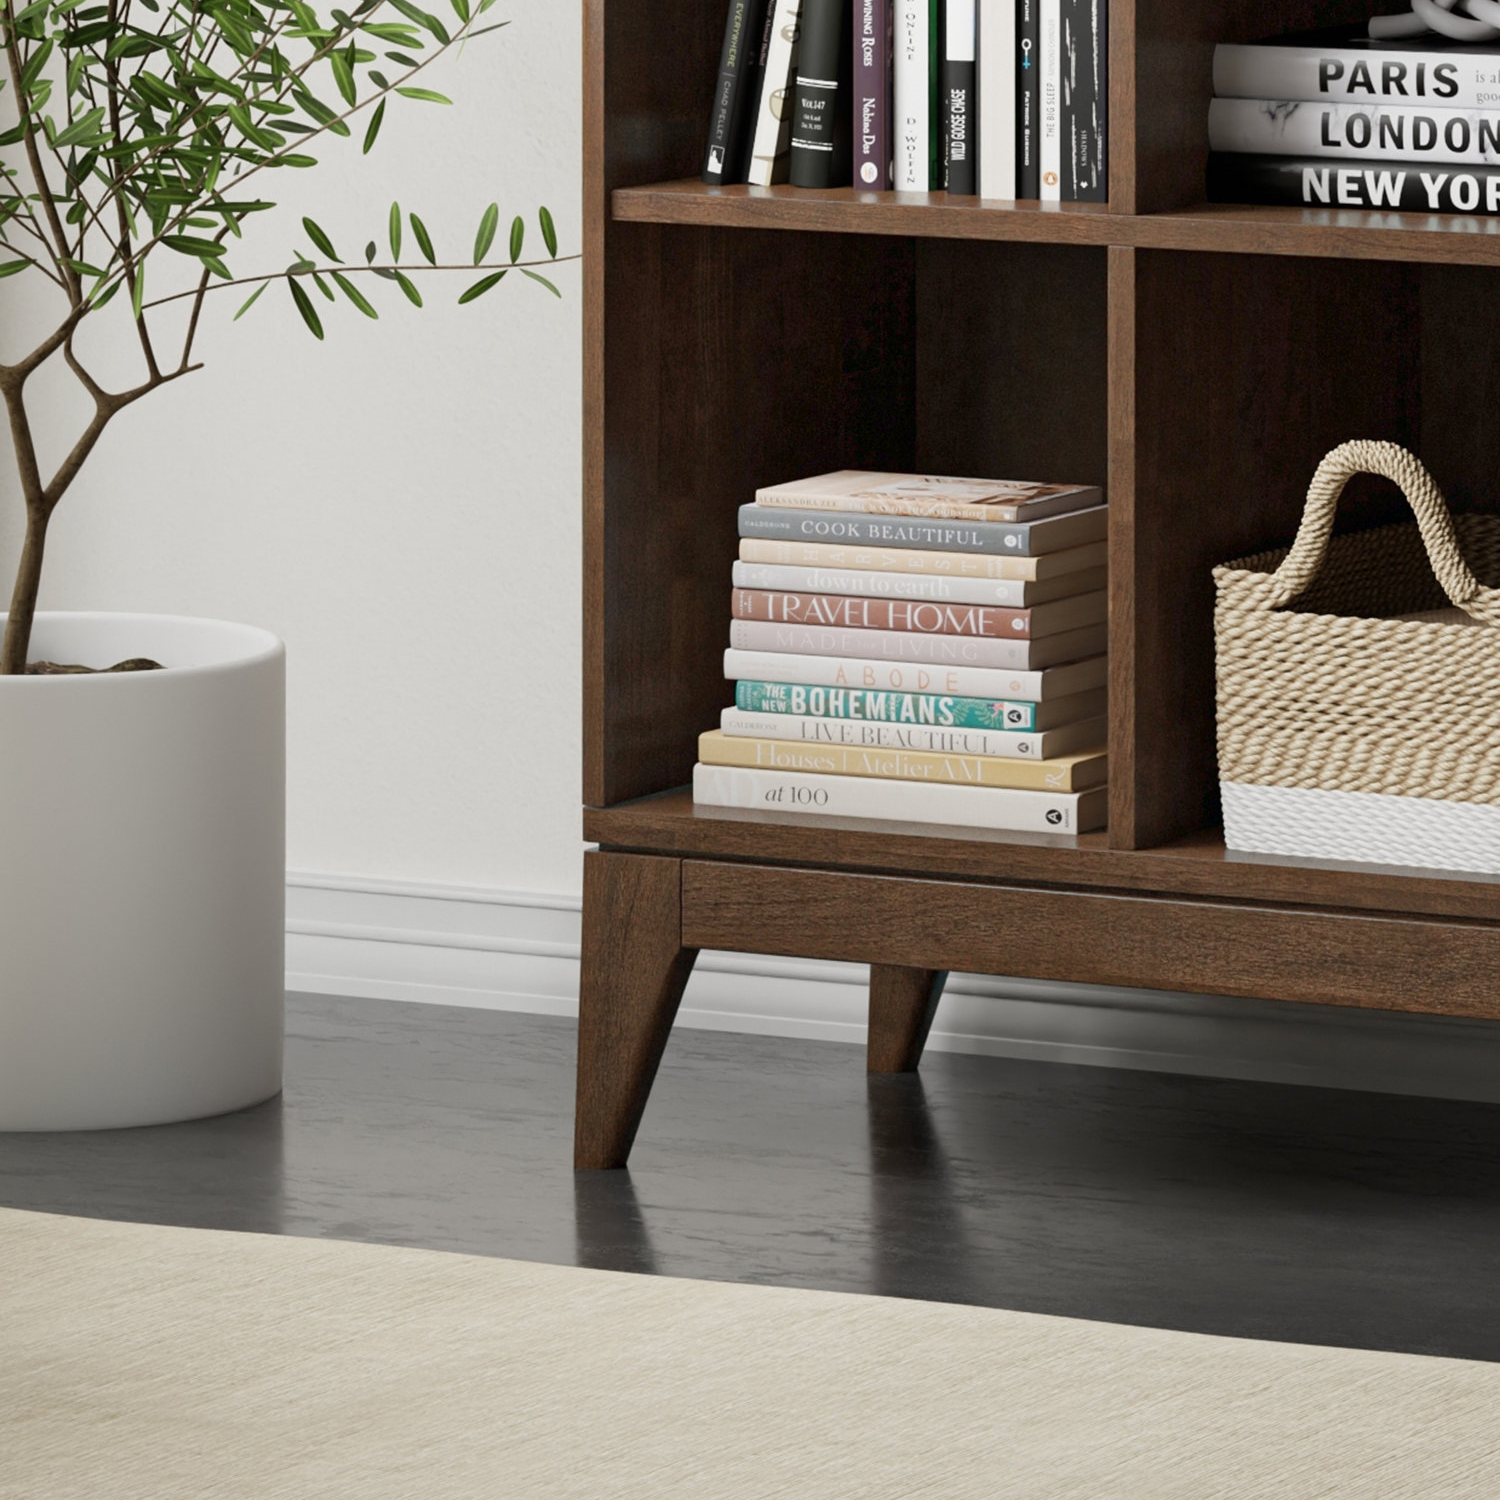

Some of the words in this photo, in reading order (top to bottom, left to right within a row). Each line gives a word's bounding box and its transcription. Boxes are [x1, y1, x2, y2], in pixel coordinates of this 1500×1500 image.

[727, 2, 744, 67] EVERYWHERE
[862, 37, 875, 66] ROSES
[721, 80, 731, 105] CHAD
[1319, 59, 1460, 98] PARIS
[1475, 70, 1486, 84] is
[951, 89, 966, 113] CHASE
[1046, 82, 1056, 106] SLEEP
[716, 108, 727, 140] PELLEY
[863, 98, 875, 133] Nabina
[951, 114, 966, 140] GOOSE
[1046, 108, 1056, 121] BIG
[863, 135, 875, 154] Das
[1046, 123, 1056, 138] THE
[951, 141, 966, 160] WILD
[1080, 130, 1088, 167] SHADOWS
[1302, 168, 1406, 207] NEW
[801, 520, 860, 537] COOK
[869, 524, 983, 546] BEAUTIFUL
[807, 568, 864, 591] down
[870, 573, 889, 593] to
[895, 576, 951, 597] earth
[762, 593, 879, 627] TRAVEL
[888, 602, 996, 636] HOME
[776, 630, 853, 652] MADE
[882, 636, 977, 661] LIVING
[765, 685, 787, 699] THE
[836, 663, 959, 692] ABODE
[761, 699, 787, 712] NEW
[791, 685, 954, 726] BOHEMIANS
[801, 722, 854, 743] LIVE
[861, 726, 996, 754] BEAUTIFUL
[756, 742, 835, 769] Houses
[856, 752, 933, 777] Atelier
[937, 758, 982, 782] AM
[765, 786, 784, 802] at
[791, 787, 828, 805] 100
